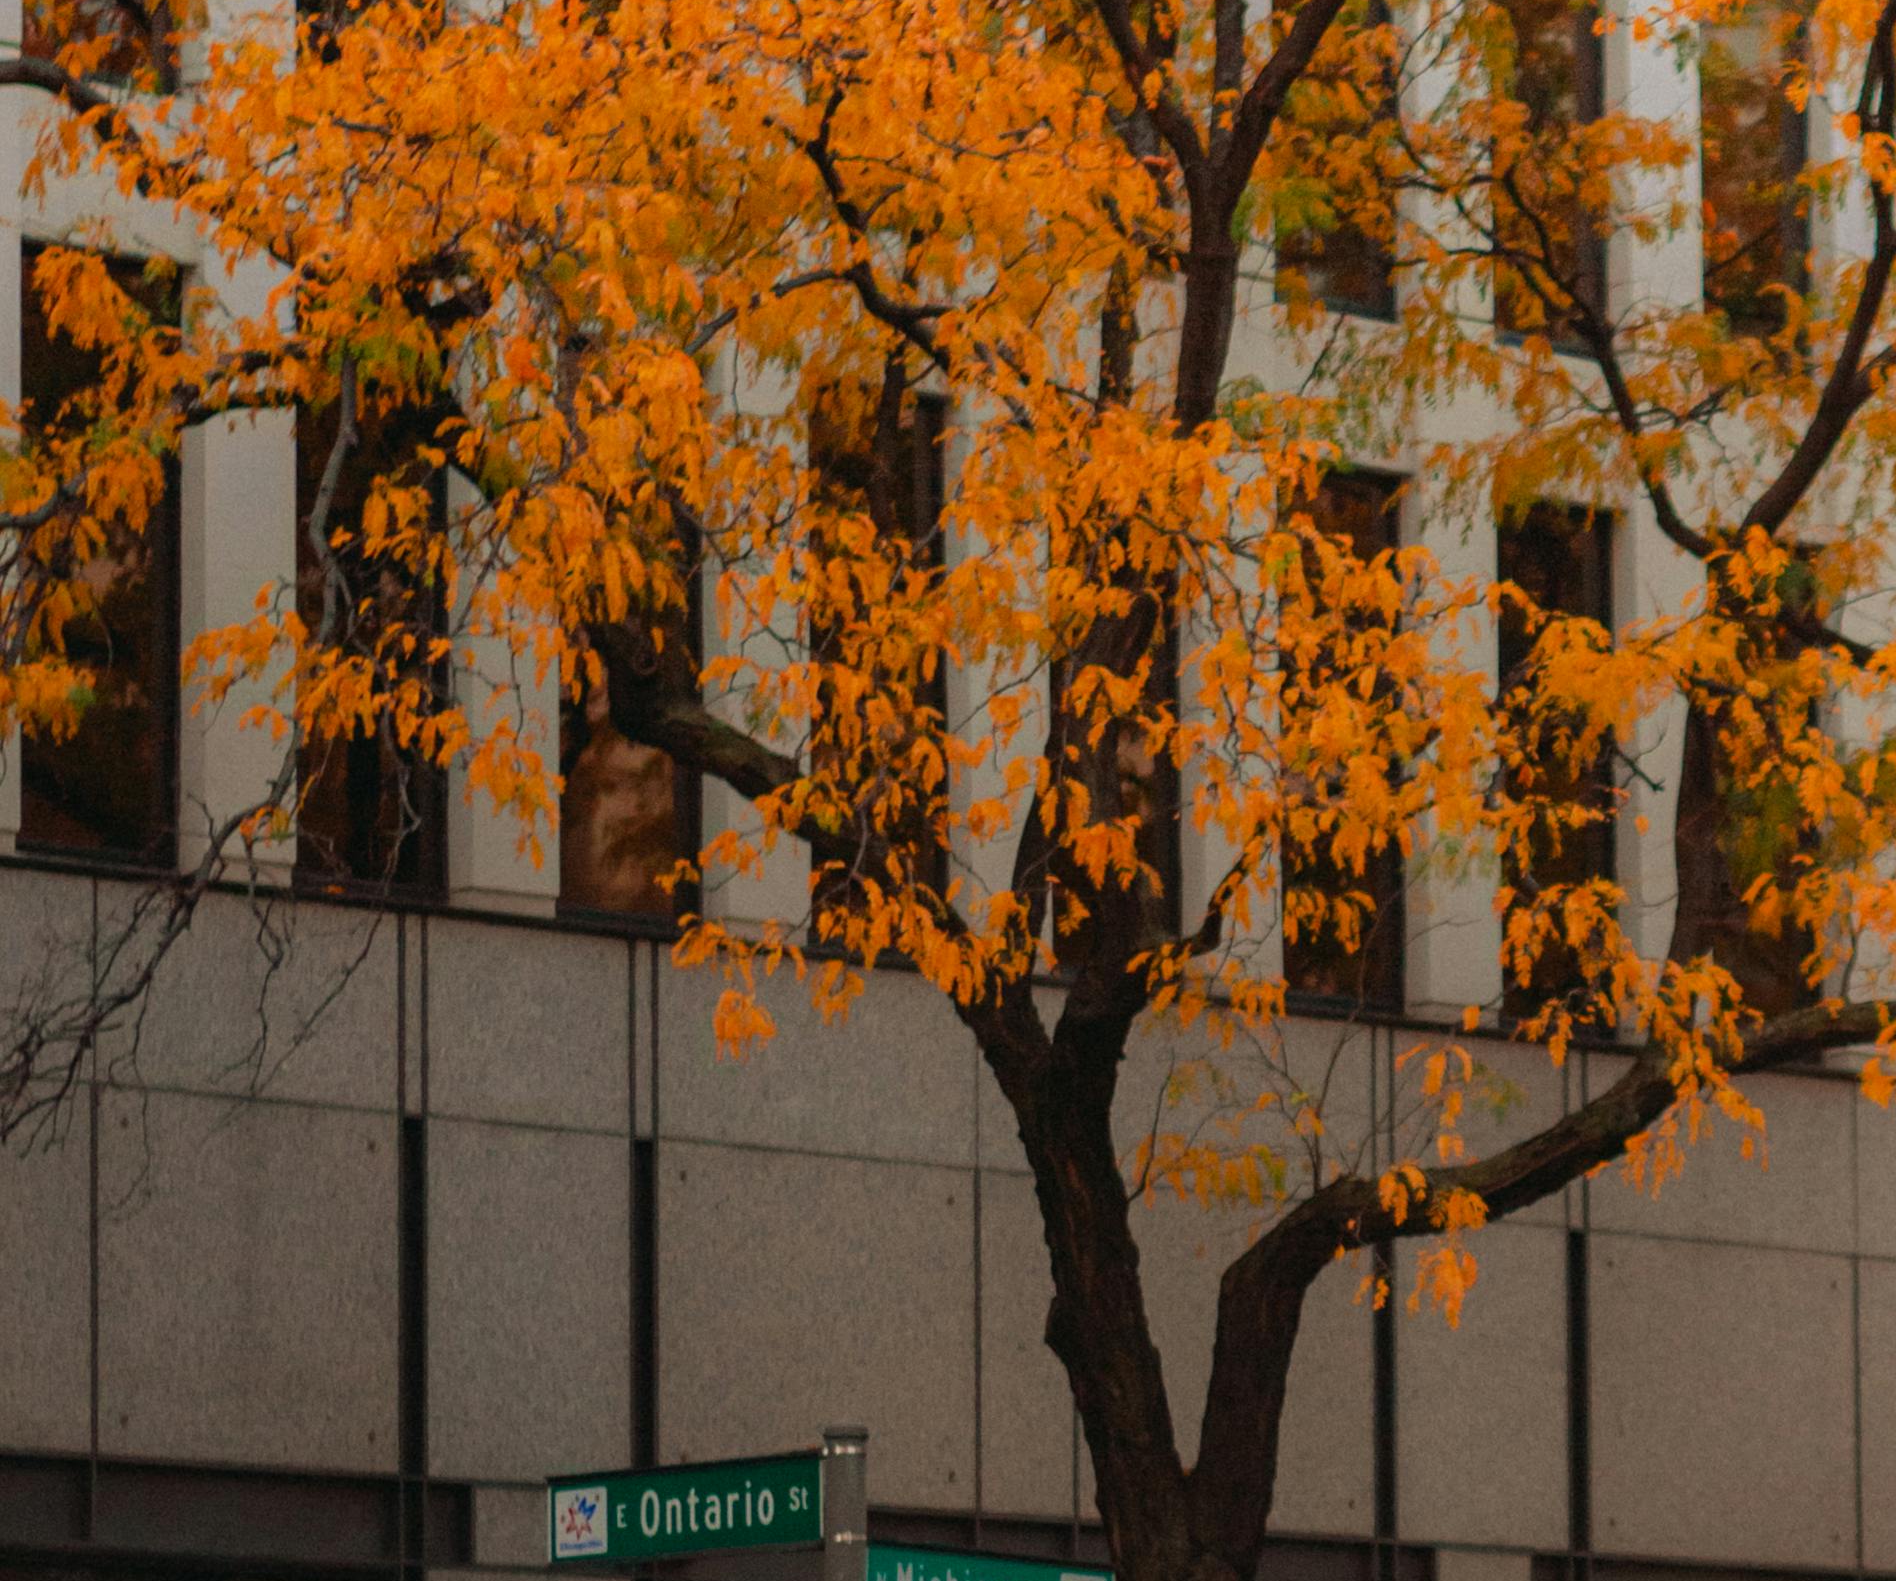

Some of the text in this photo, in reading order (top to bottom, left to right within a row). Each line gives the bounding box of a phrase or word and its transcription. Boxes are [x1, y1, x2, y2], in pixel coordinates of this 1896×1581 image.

[616, 1481, 809, 1537] E Ontario St
